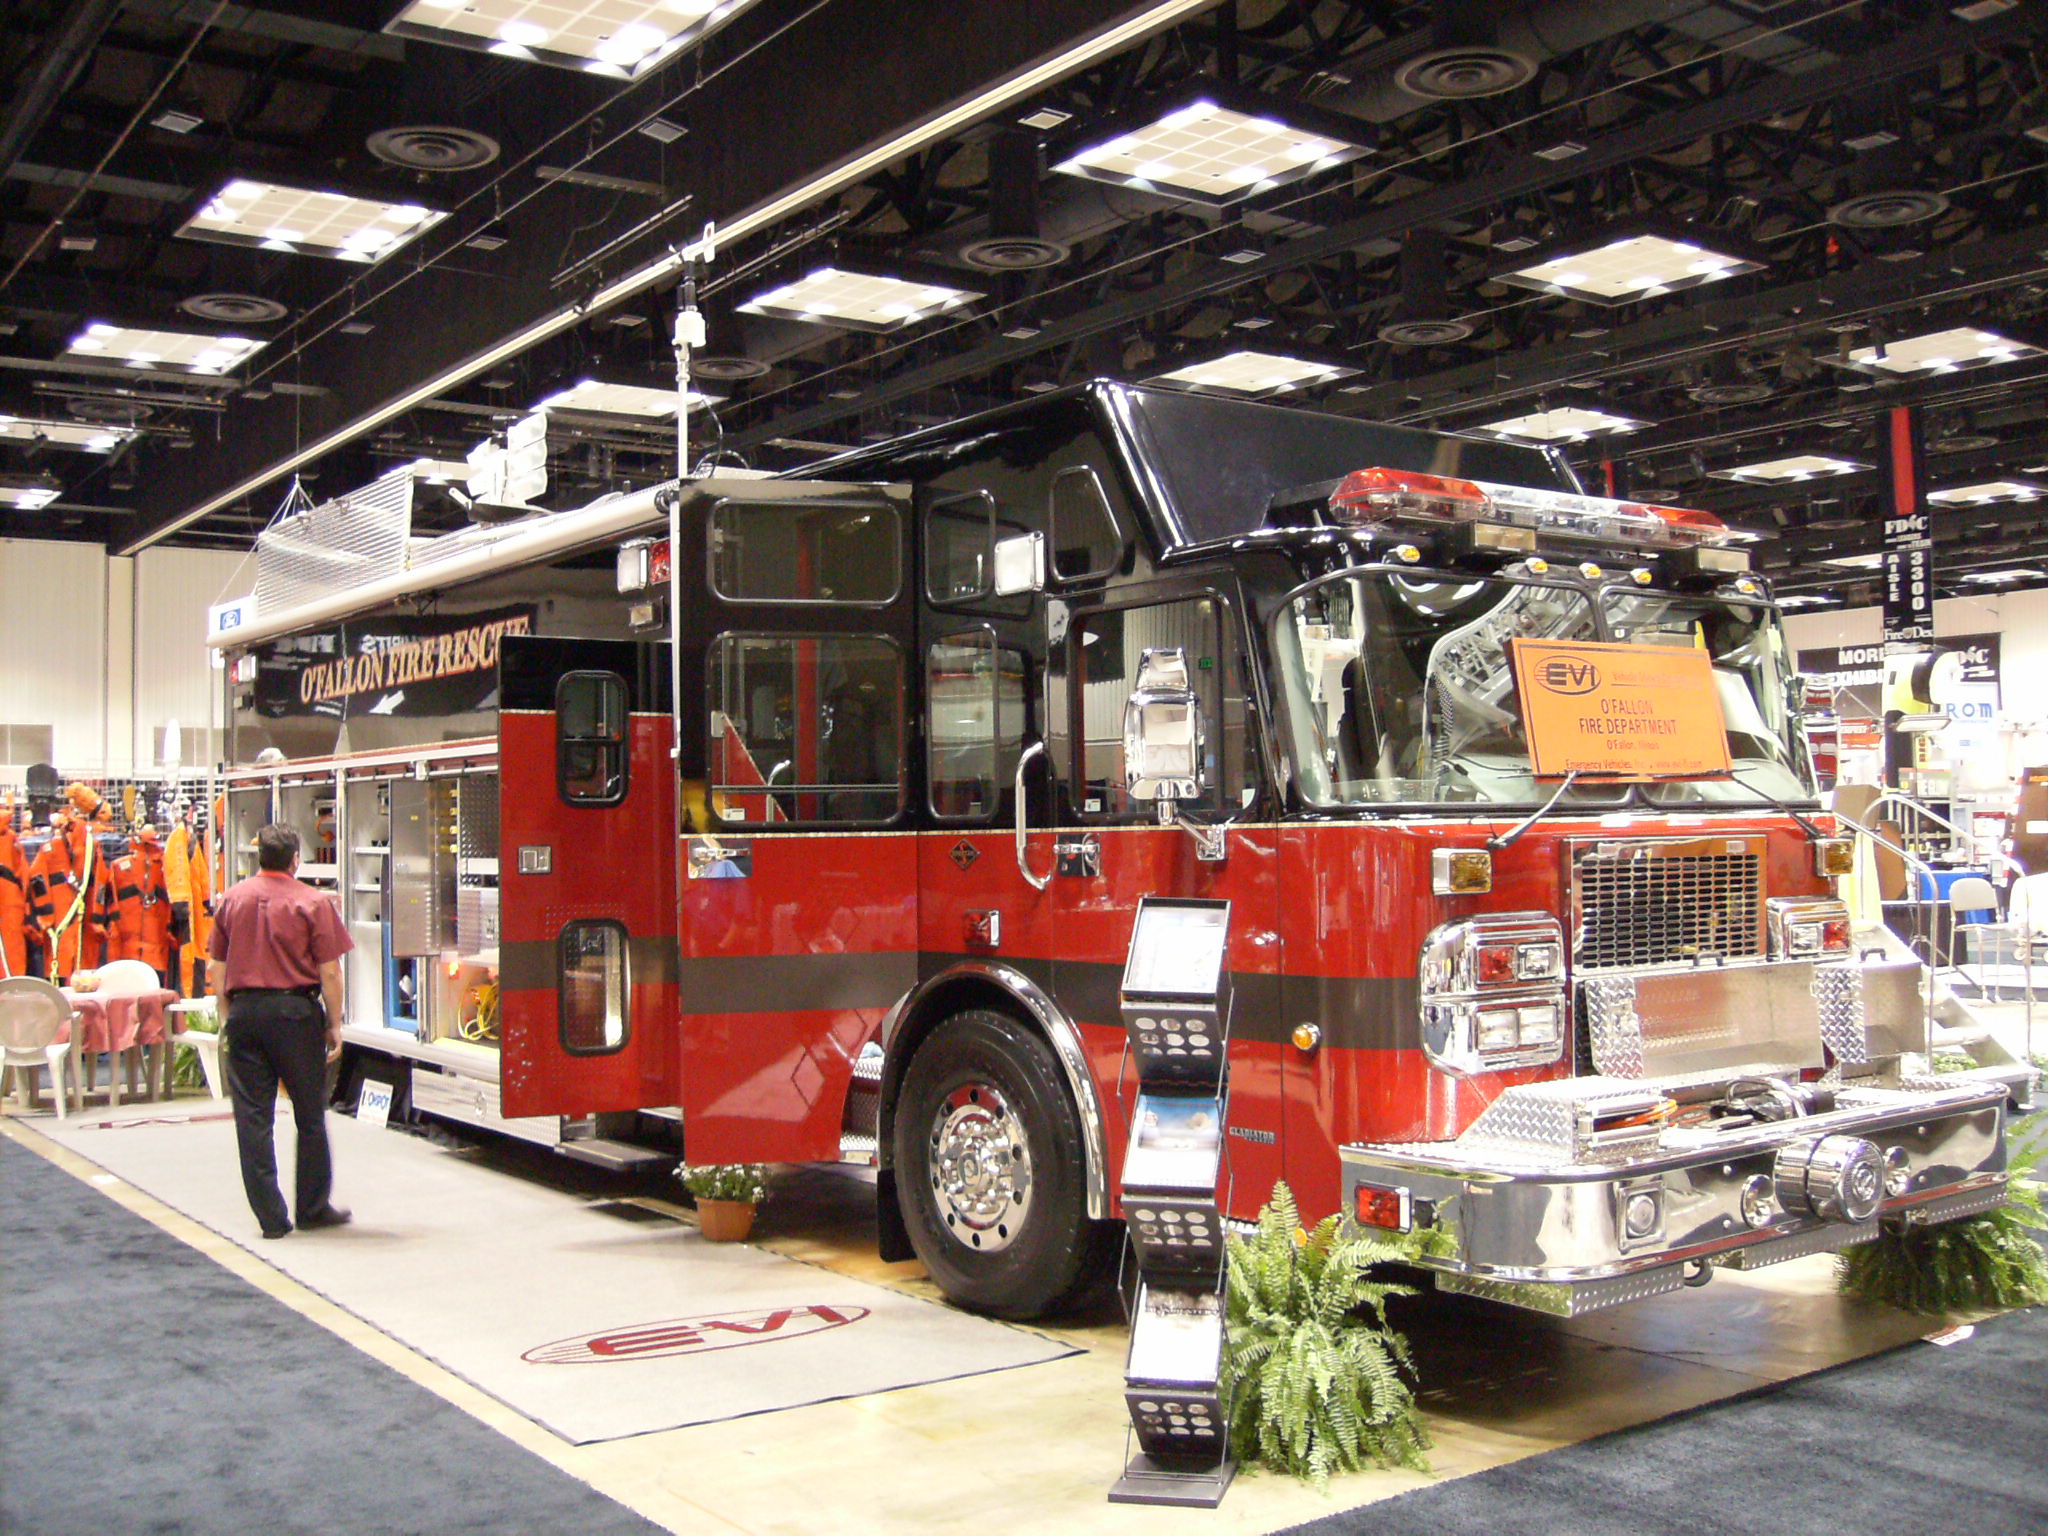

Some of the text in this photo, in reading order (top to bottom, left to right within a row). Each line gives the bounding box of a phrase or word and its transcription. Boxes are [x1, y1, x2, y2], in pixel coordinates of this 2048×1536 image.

[1888, 554, 1900, 602] AISLE
[1911, 552, 1925, 610] 3300
[301, 651, 387, 705] O'FALLON
[386, 636, 435, 688] FIRE
[1546, 662, 1597, 687] EVI
[1601, 698, 1654, 715] O'FALLON
[1579, 718, 1678, 736] FIRE DEPARTMENT
